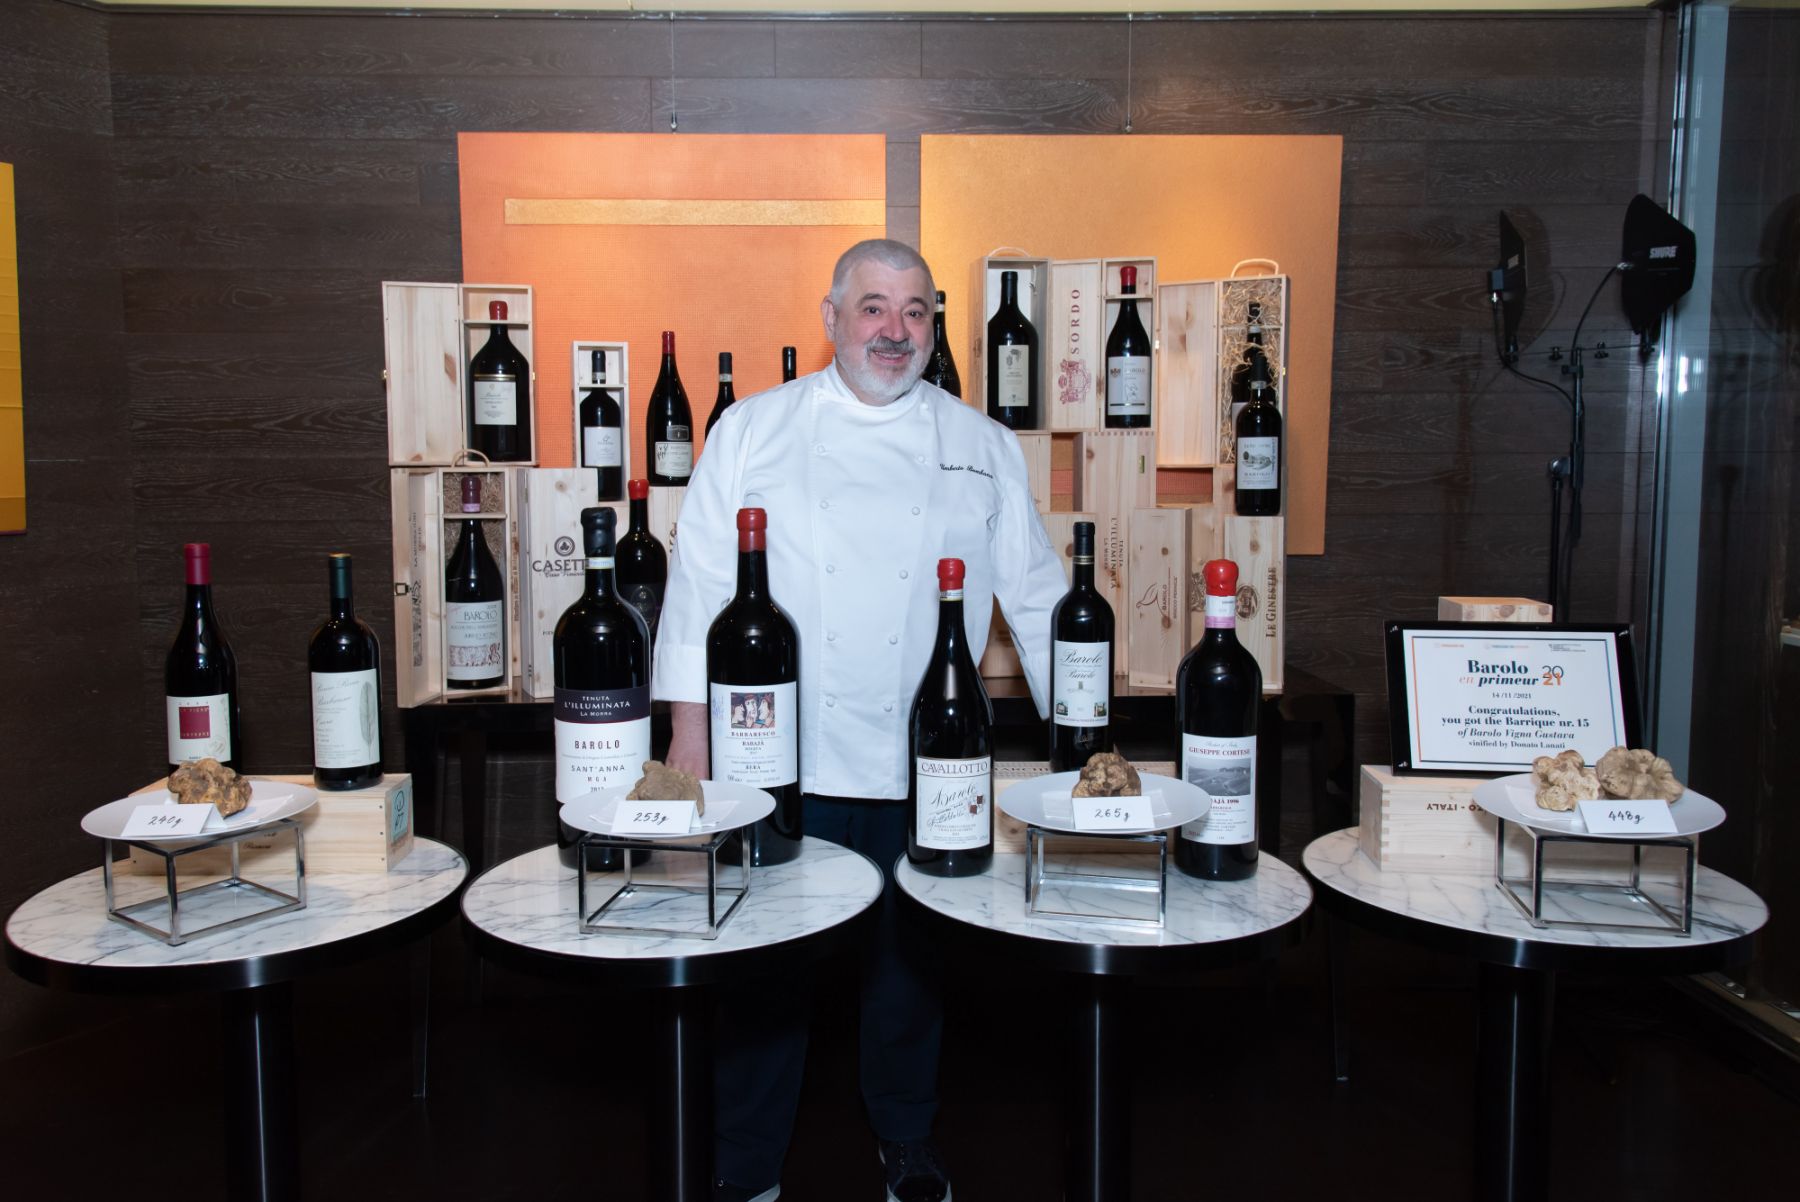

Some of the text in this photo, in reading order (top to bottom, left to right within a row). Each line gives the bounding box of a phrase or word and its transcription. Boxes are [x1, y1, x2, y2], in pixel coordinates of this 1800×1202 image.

[1070, 289, 1081, 355] SORDO
[532, 558, 588, 573] CASETT
[1265, 567, 1277, 622] GINESTRE
[1467, 659, 1529, 674] Barolo
[1459, 676, 1475, 685] en
[1478, 674, 1539, 688] primeur
[564, 701, 631, 710] L'ILLUMINATA
[1468, 705, 1561, 717] Congratulations,
[1442, 717, 1461, 727] you
[1464, 717, 1482, 727] got
[1485, 716, 1503, 725] the
[1505, 716, 1556, 729] Barrique
[1577, 718, 1590, 728] 15
[1457, 727, 1469, 739] of
[1470, 728, 1502, 737] Barolo
[1505, 729, 1532, 739] Vigna
[574, 739, 621, 750] BAROLO
[1188, 746, 1251, 756] GIUSEPPE CORTESE
[1499, 740, 1508, 749] by
[571, 764, 626, 773] SANT'ANNA
[921, 761, 988, 775] CAVALLOTTO
[1426, 803, 1458, 811] ITALY
[633, 811, 669, 826] 253g
[1607, 810, 1646, 825] 448g
